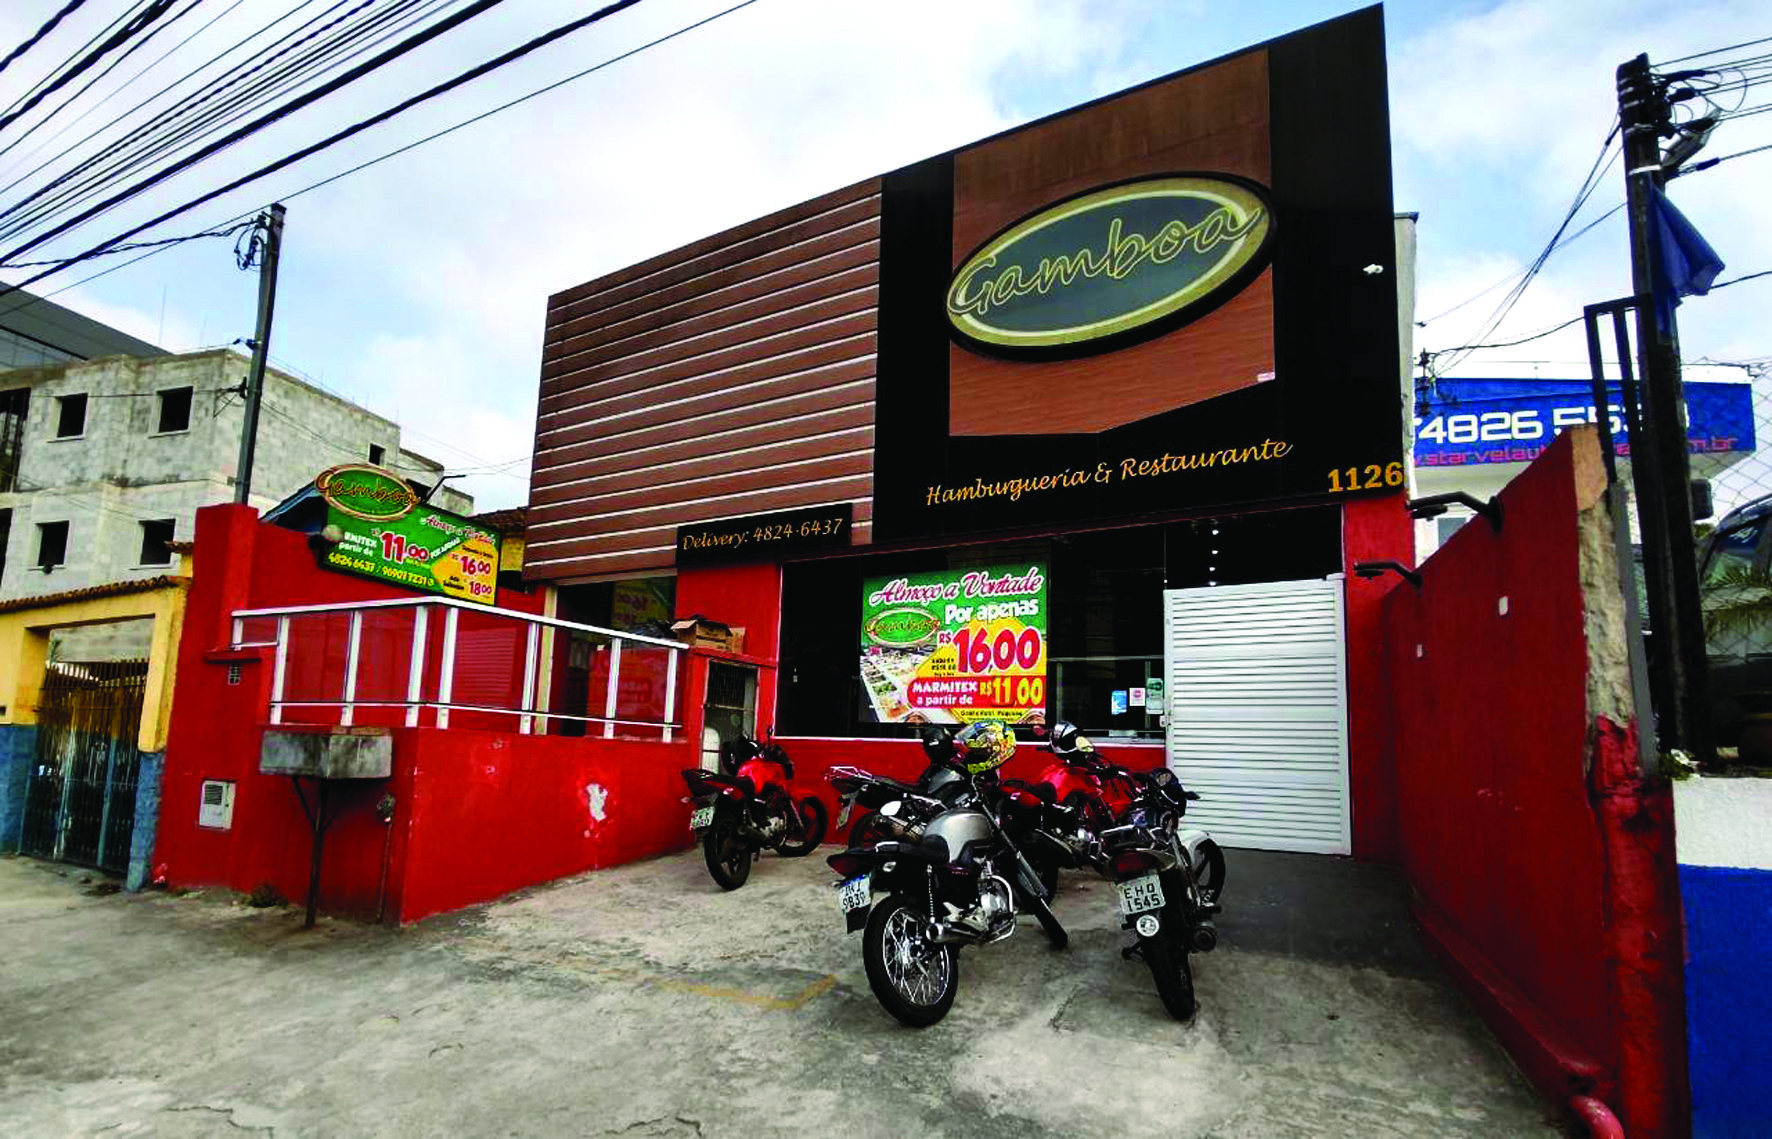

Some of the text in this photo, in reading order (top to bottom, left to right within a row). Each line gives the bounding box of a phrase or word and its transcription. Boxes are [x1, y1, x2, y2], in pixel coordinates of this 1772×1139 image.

[947, 208, 1262, 315] Gamboa
[1418, 410, 1543, 444] 4826
[1094, 463, 1112, 483] &
[1120, 438, 1293, 479] Restaurante
[1327, 462, 1403, 493] 1126
[682, 518, 843, 550] Delivery: 4824-6437
[869, 578, 943, 606] Almoço
[944, 583, 960, 598] a
[945, 599, 1039, 624] Por apenas
[938, 630, 953, 646] R$
[912, 680, 978, 694] MARMITEX
[979, 681, 993, 696] R$
[916, 694, 974, 707] a partir de
[1127, 894, 1160, 912] 1545
